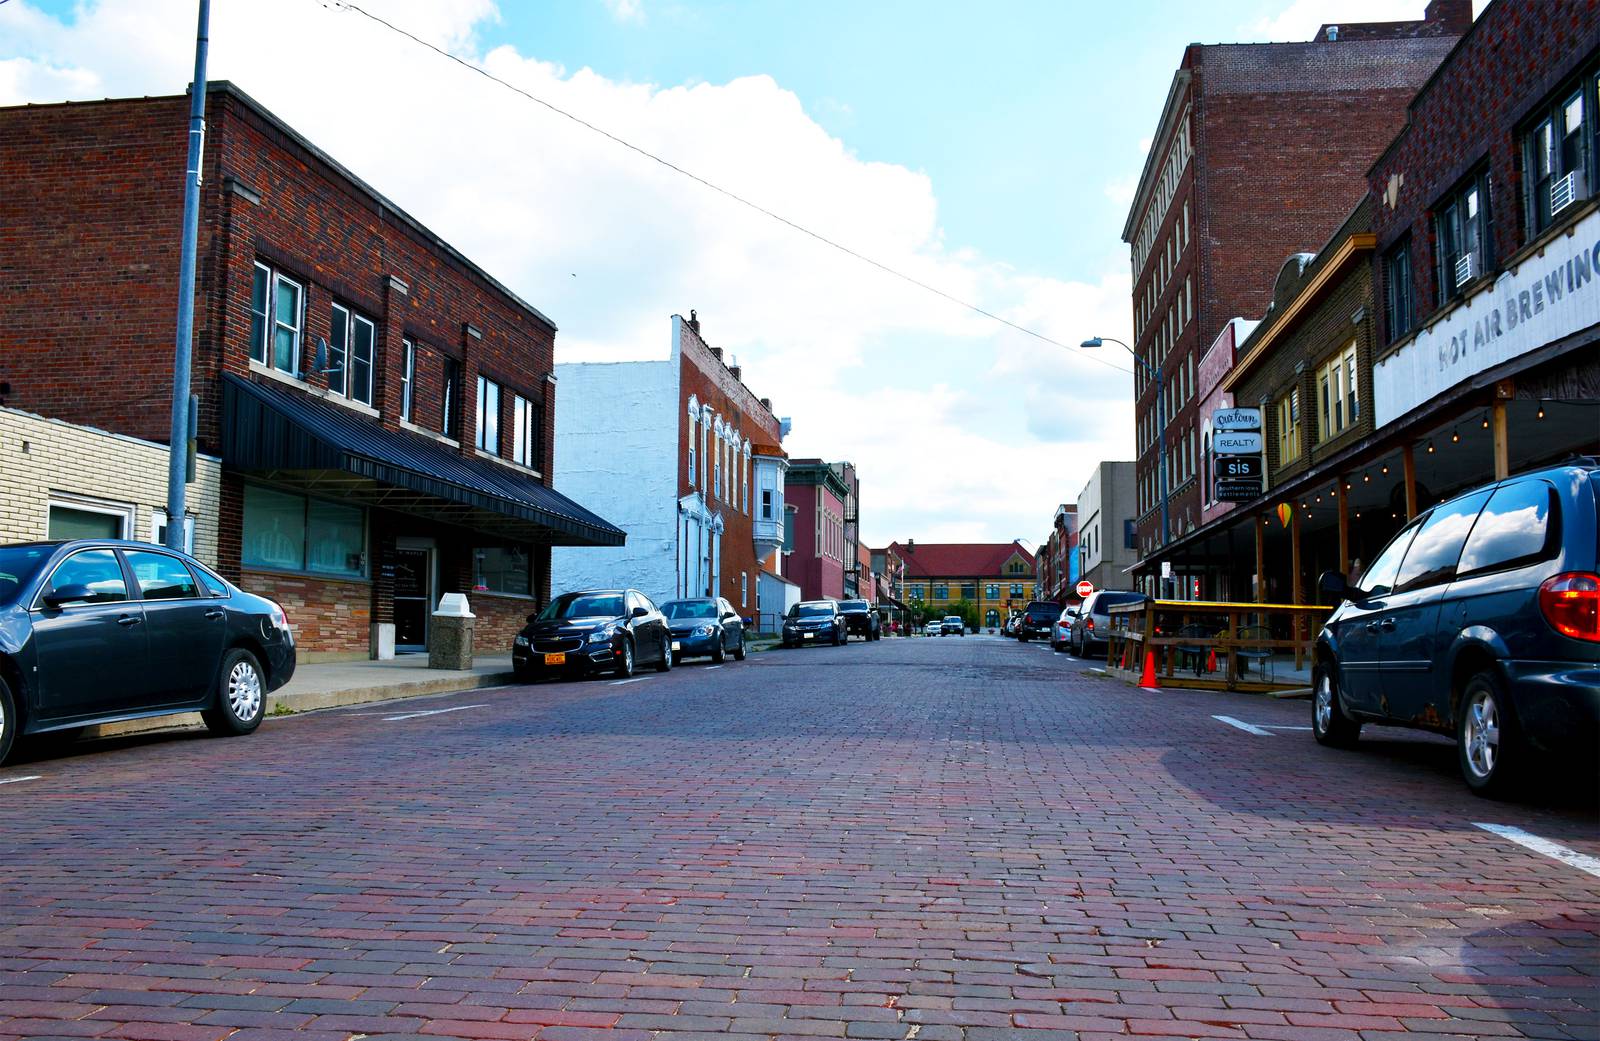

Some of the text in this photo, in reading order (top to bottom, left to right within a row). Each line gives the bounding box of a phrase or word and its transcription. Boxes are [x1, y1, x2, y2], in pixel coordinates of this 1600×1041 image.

[1439, 328, 1467, 372] HOT
[1474, 308, 1503, 352] AIR
[1220, 439, 1255, 447] REALTY
[1078, 585, 1092, 593] STOP
